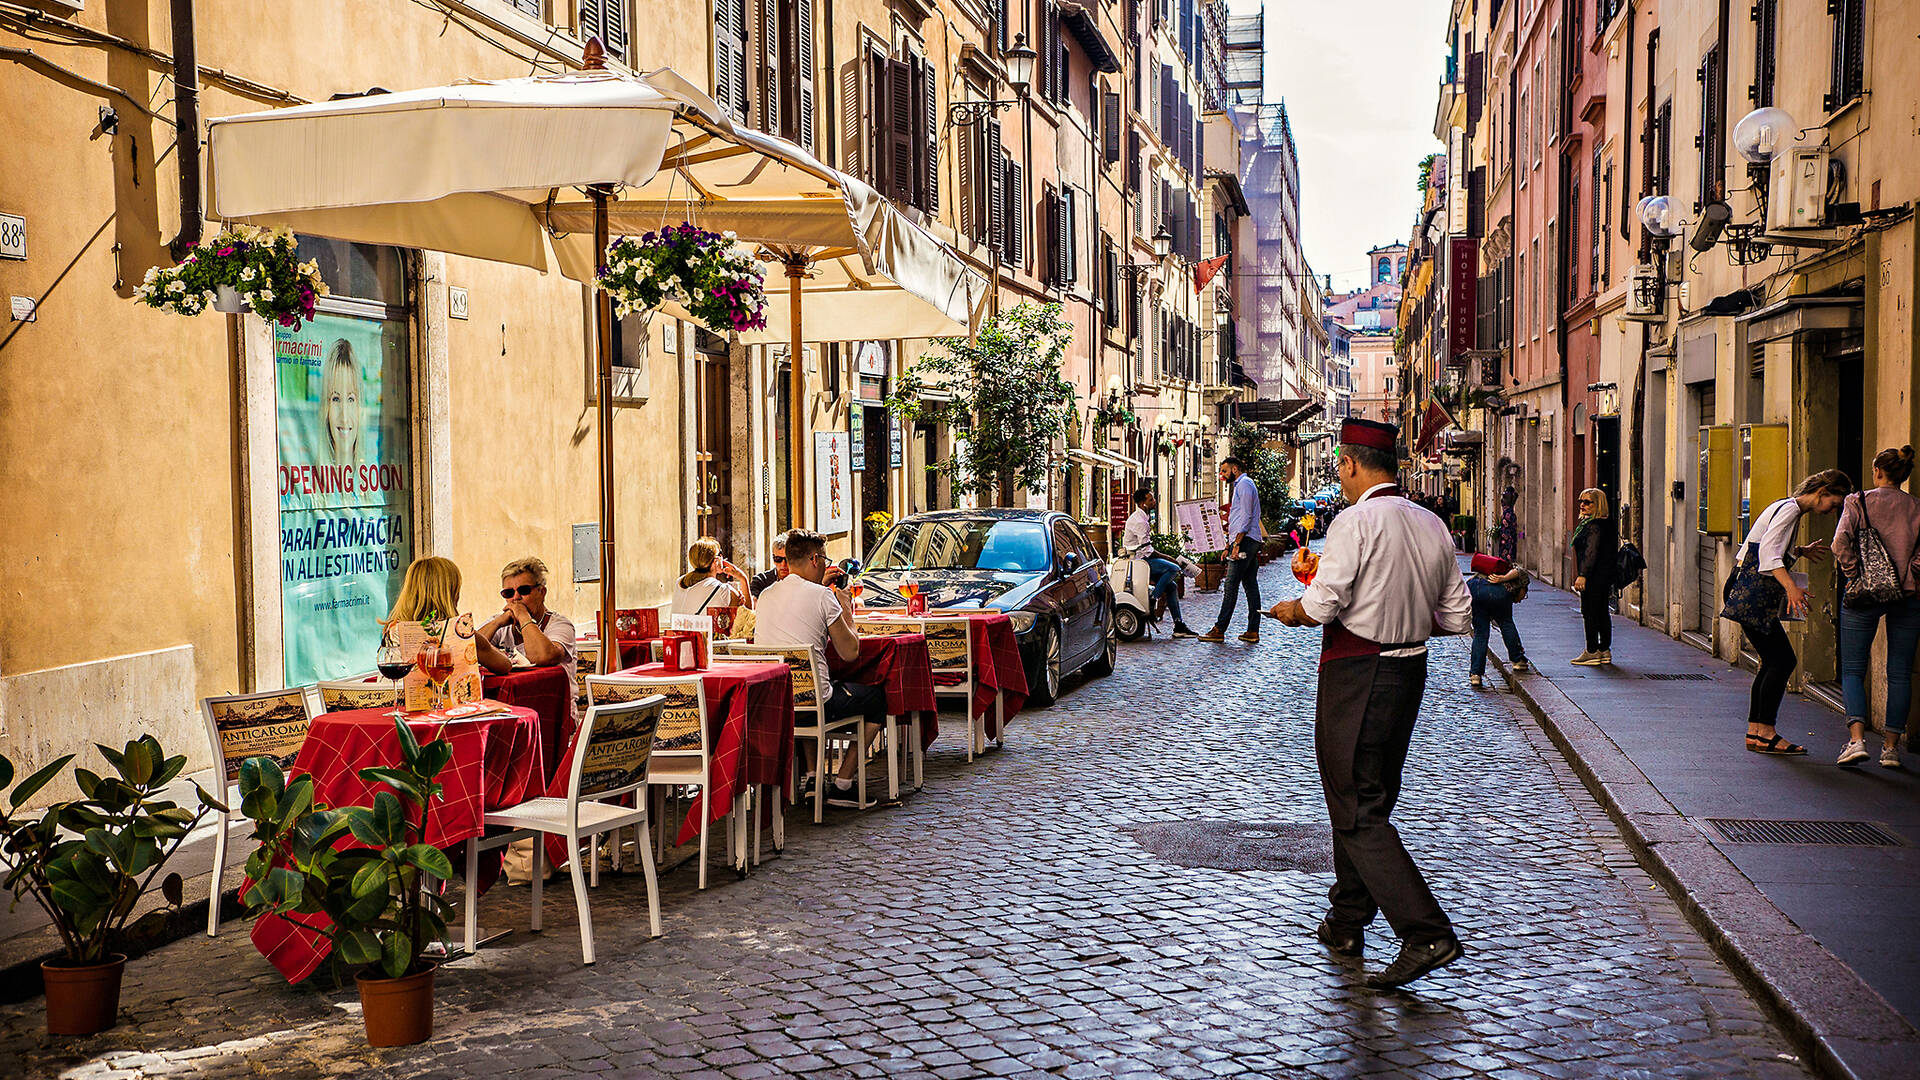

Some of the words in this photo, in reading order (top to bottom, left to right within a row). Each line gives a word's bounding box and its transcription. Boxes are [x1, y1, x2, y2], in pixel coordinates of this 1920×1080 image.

[1, 221, 25, 248] 88A
[1460, 252, 1468, 300] HOTEL
[452, 292, 467, 313] 89
[1459, 307, 1467, 344] HOMS
[276, 339, 323, 357] rmacrimi
[666, 329, 675, 347] 90
[279, 464, 354, 496] OPENING
[359, 463, 403, 492] SOON
[297, 549, 400, 580] ALLESTIMENTO
[313, 594, 370, 612] www.farmacrimi.it
[222, 723, 309, 742] ANTICAROMA
